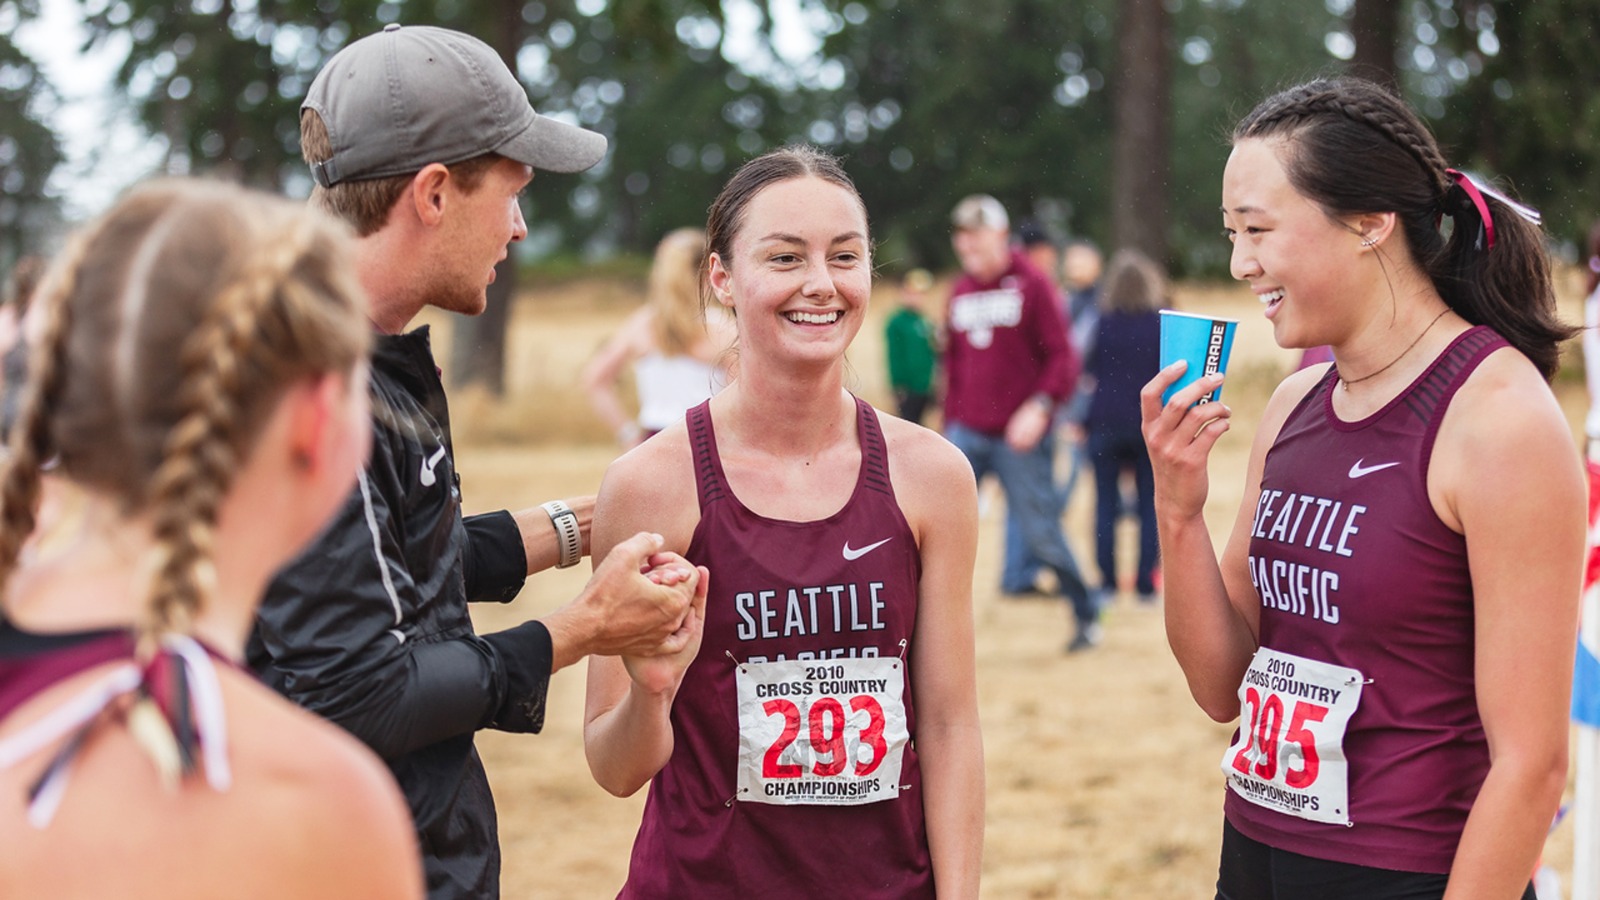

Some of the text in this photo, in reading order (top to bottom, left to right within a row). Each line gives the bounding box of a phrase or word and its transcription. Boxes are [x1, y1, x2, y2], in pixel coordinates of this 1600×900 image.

[1250, 489, 1367, 557] SEATTLE
[735, 581, 886, 641] SEATTLE
[805, 665, 845, 680] 2010
[1246, 668, 1342, 705] CROSS COUNTRY
[1267, 658, 1295, 678] 2010
[756, 679, 888, 698] CROSS COUNTRY
[762, 695, 888, 779] 293
[1232, 687, 1330, 789] 295
[764, 778, 880, 796] CHAMPIONSHIPS
[1232, 773, 1320, 811] CHAMPIONSHIPS
